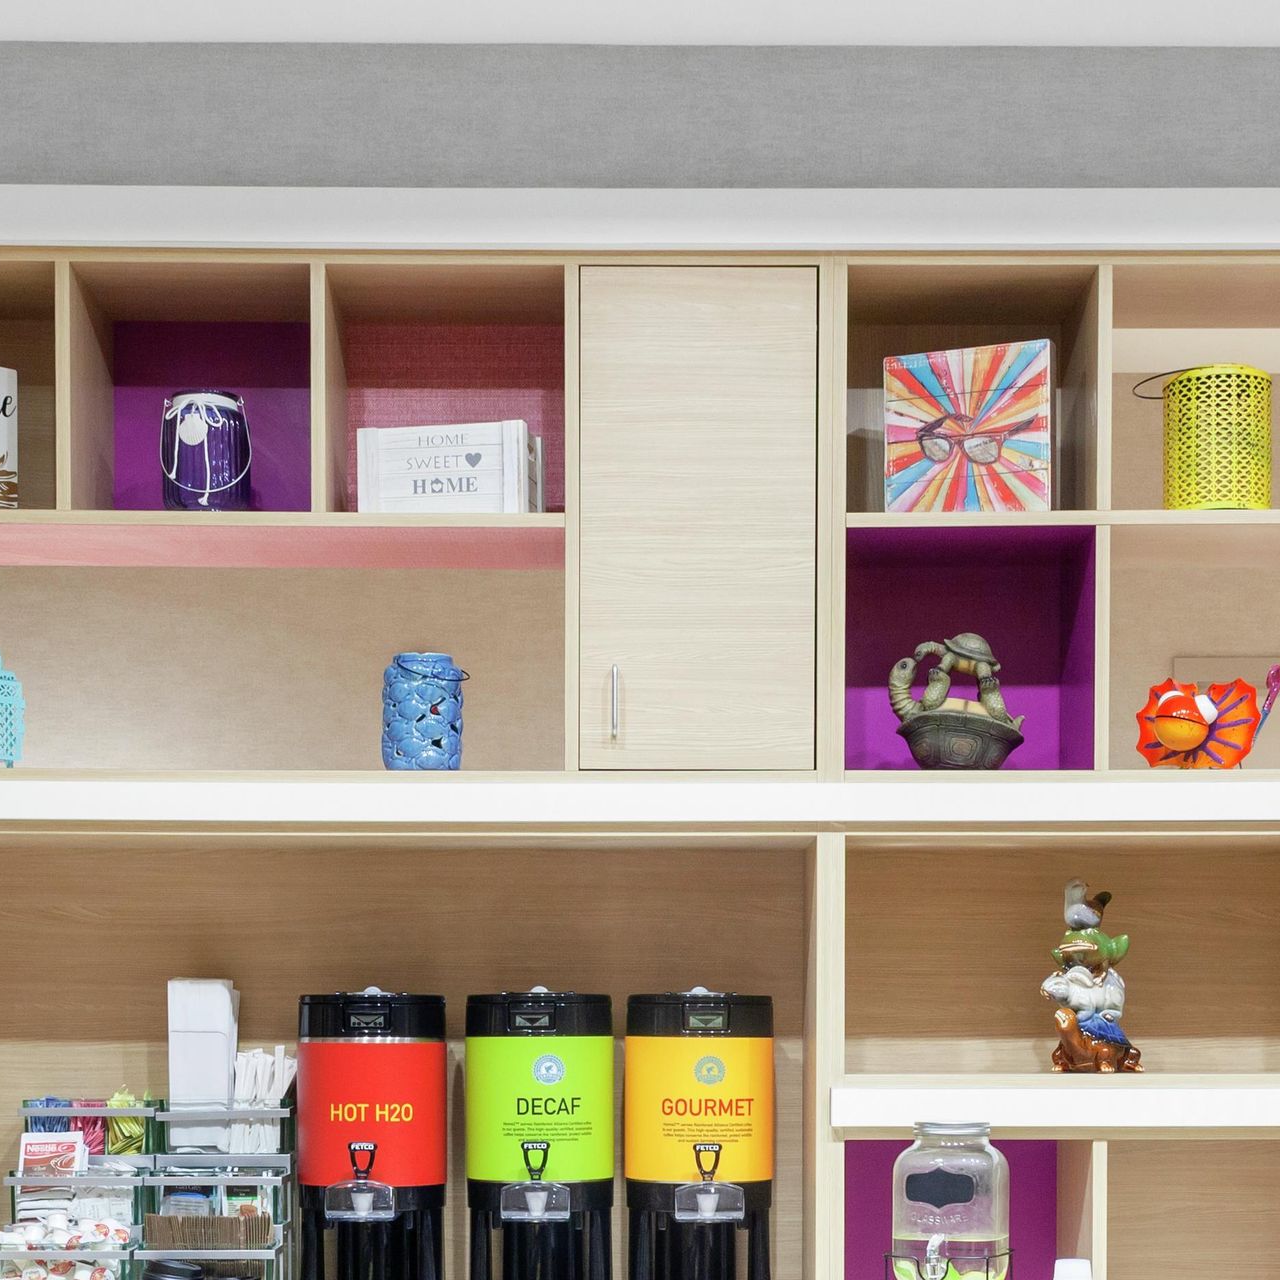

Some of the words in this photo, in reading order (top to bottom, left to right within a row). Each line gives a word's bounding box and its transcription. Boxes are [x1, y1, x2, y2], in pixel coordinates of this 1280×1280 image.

[417, 433, 469, 447] HOME
[406, 455, 463, 470] SWEET
[330, 1103, 370, 1122] HOT
[517, 1097, 581, 1116] DECAF
[661, 1098, 754, 1117] GOURMET
